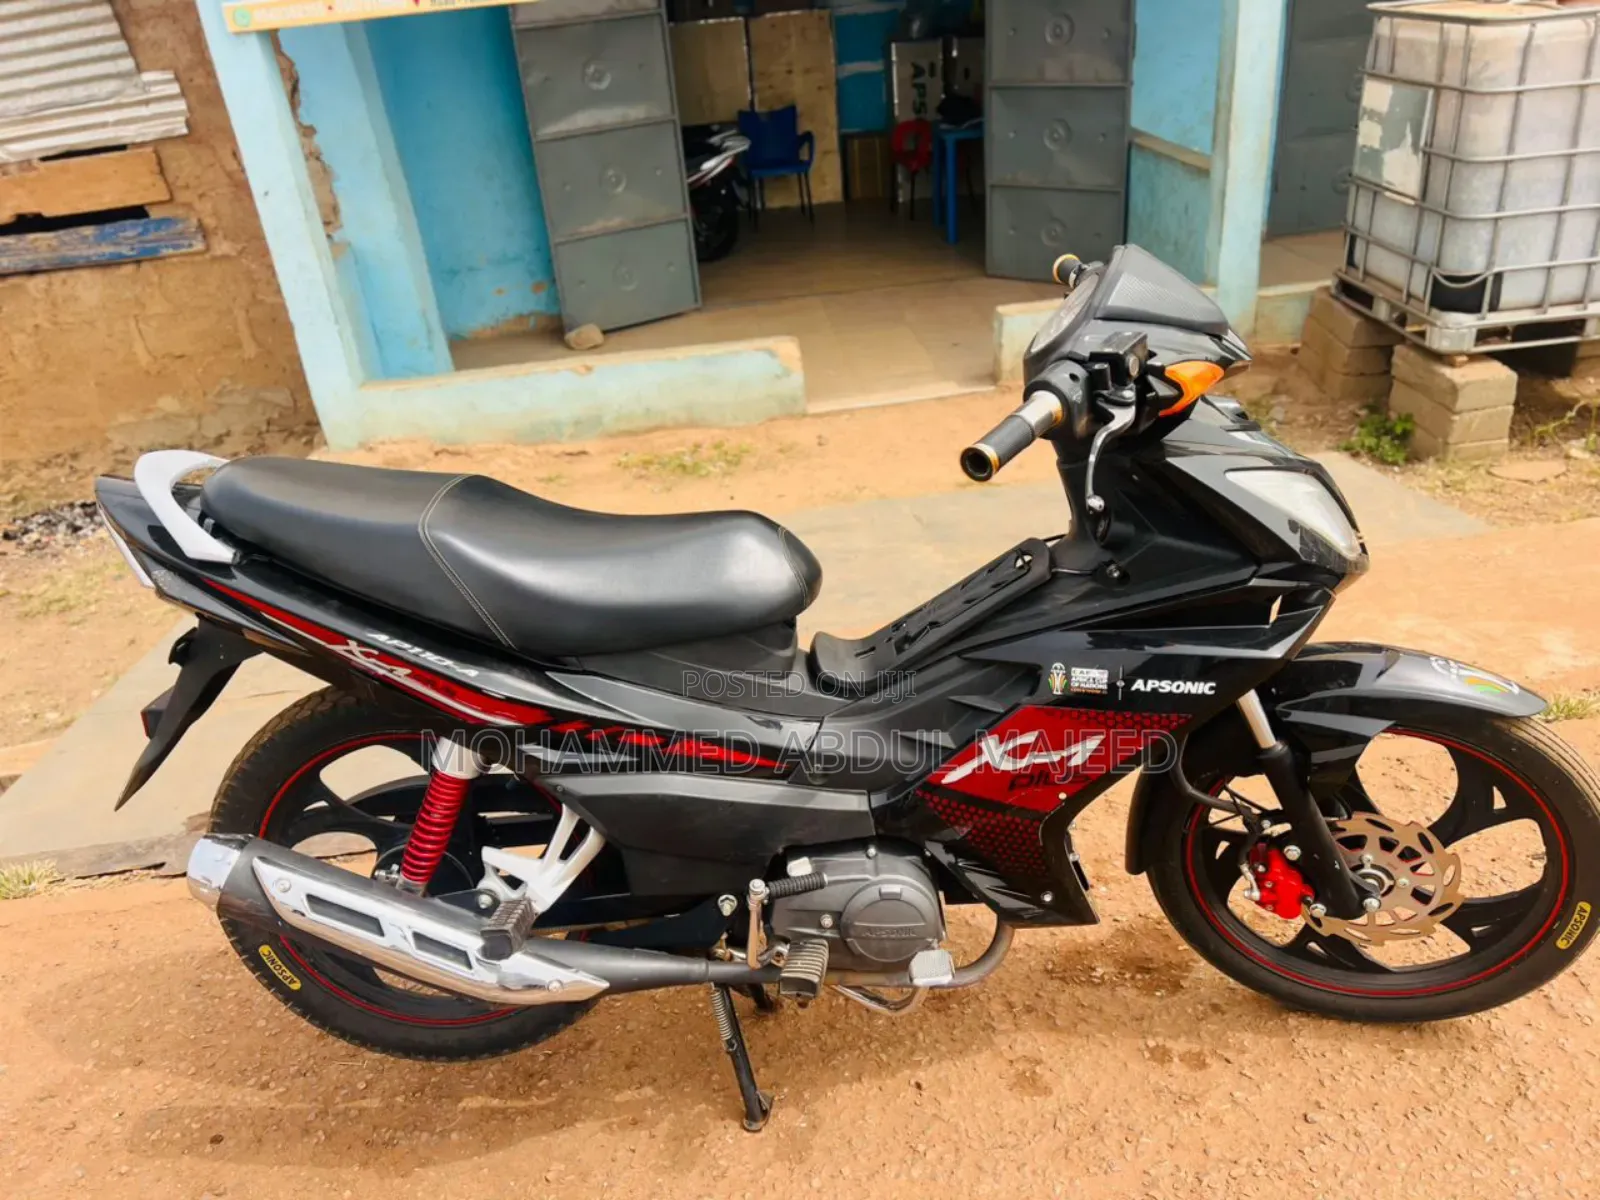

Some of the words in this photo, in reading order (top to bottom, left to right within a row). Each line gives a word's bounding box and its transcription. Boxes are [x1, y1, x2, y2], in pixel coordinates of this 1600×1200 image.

[1131, 679, 1216, 695] APSONIC
[1560, 904, 1588, 946] APSONIC
[262, 949, 297, 985] APSONIC
